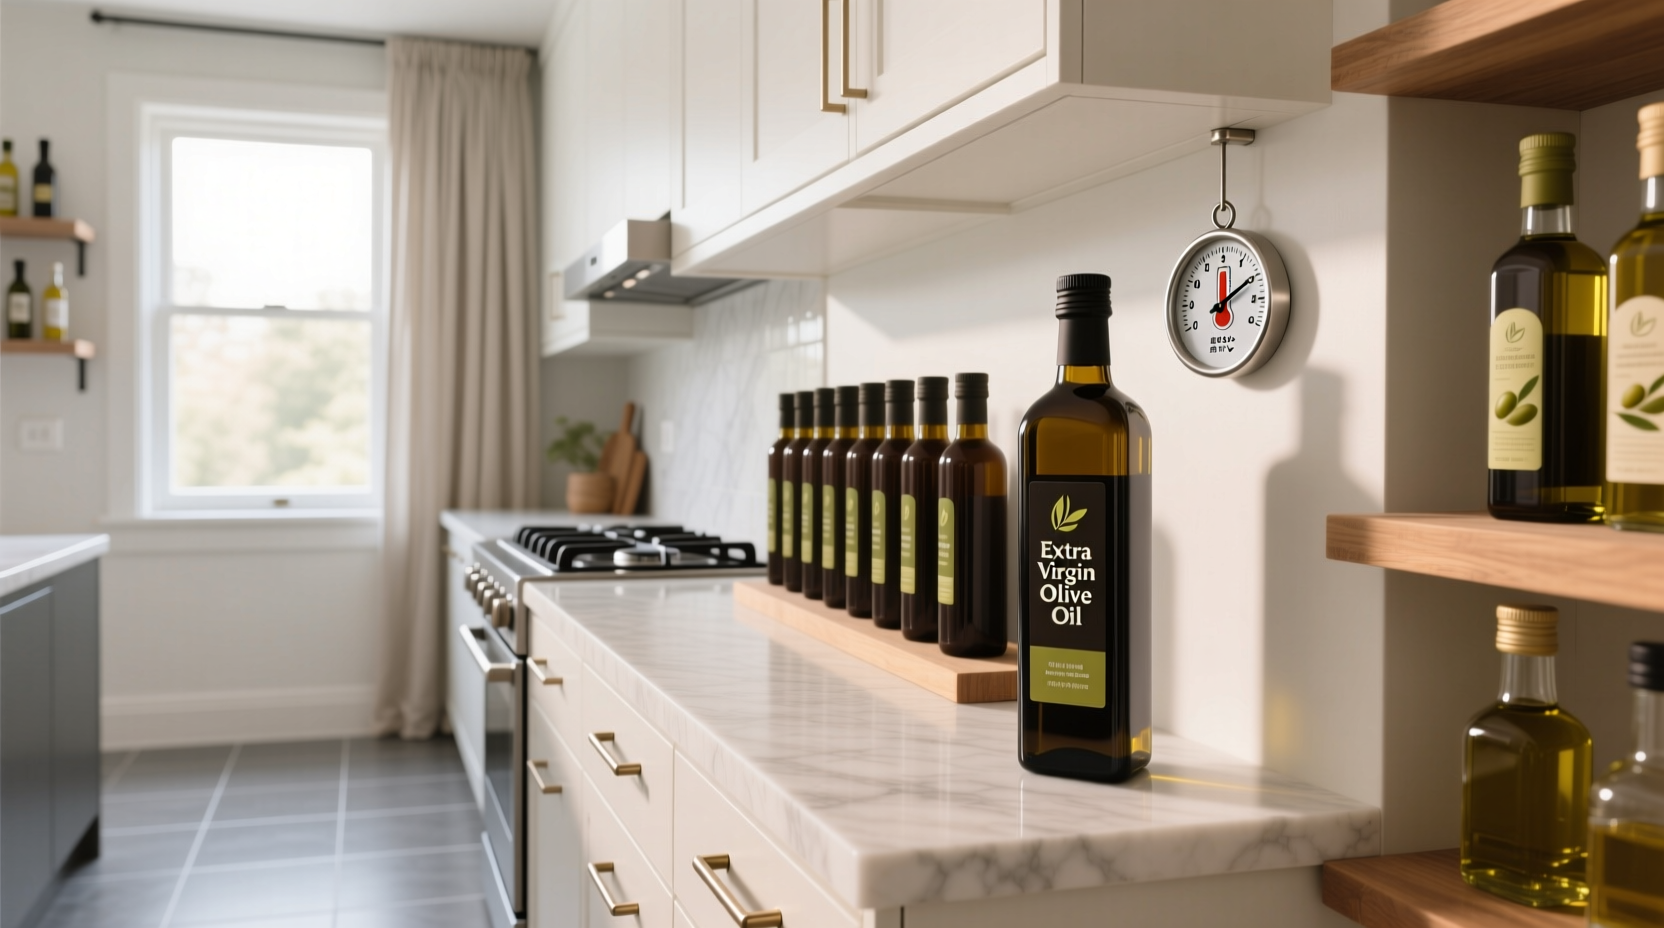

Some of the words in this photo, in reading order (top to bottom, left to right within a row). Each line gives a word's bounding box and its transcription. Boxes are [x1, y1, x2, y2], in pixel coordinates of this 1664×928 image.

[1041, 541, 1092, 560] Extra
[1037, 561, 1095, 585] Virgin
[1040, 584, 1092, 604] Olive
[1052, 606, 1082, 625] Oil
